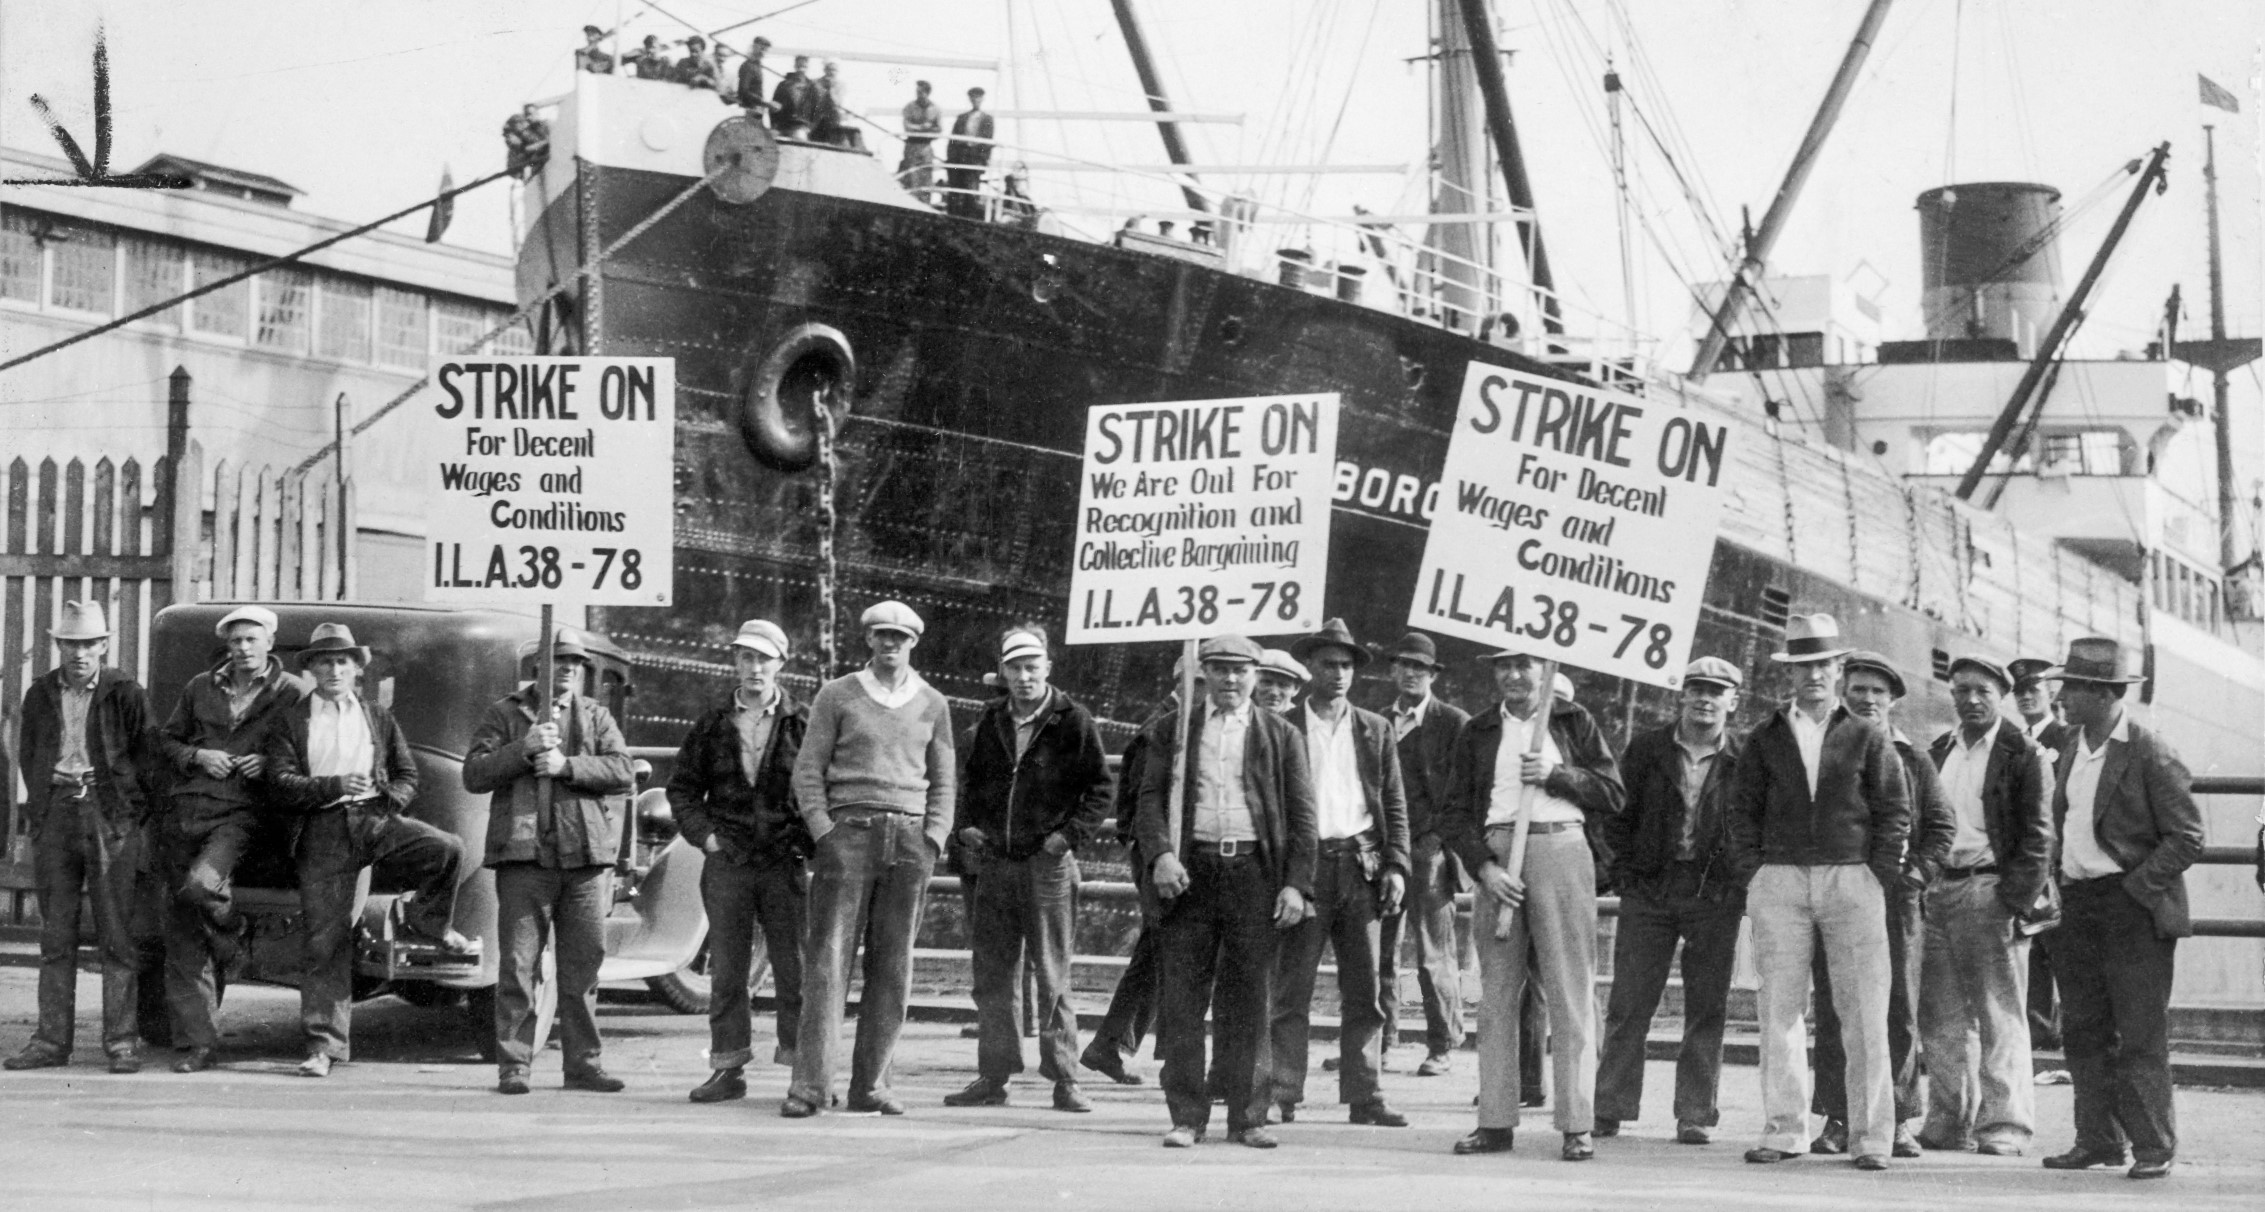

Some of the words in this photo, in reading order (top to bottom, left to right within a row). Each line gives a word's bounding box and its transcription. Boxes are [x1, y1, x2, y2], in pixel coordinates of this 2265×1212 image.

[435, 363, 580, 420] STRIKE
[600, 365, 655, 421] ON
[466, 427, 506, 456] For
[514, 428, 594, 457] Decent
[1094, 406, 1244, 464] STRIKE
[1261, 402, 1318, 456] ON
[1470, 375, 1643, 468] STRIKE
[1657, 417, 1727, 487] ON
[441, 463, 521, 496] Wages
[540, 466, 582, 494] and
[1091, 472, 1126, 499] We
[1134, 471, 1178, 497] Are
[1191, 466, 1233, 493] Out
[1252, 464, 1297, 491] For
[1517, 453, 1567, 493] For
[1577, 467, 1666, 518] Decent
[491, 500, 626, 532] Conditions
[1087, 502, 1236, 537] Recognition
[1250, 498, 1303, 527] and
[1457, 479, 1548, 530] Wages
[1562, 516, 1615, 547] and
[1080, 541, 1176, 571] Collective
[1181, 534, 1299, 572] Bargaining
[1518, 538, 1676, 603] Conditions
